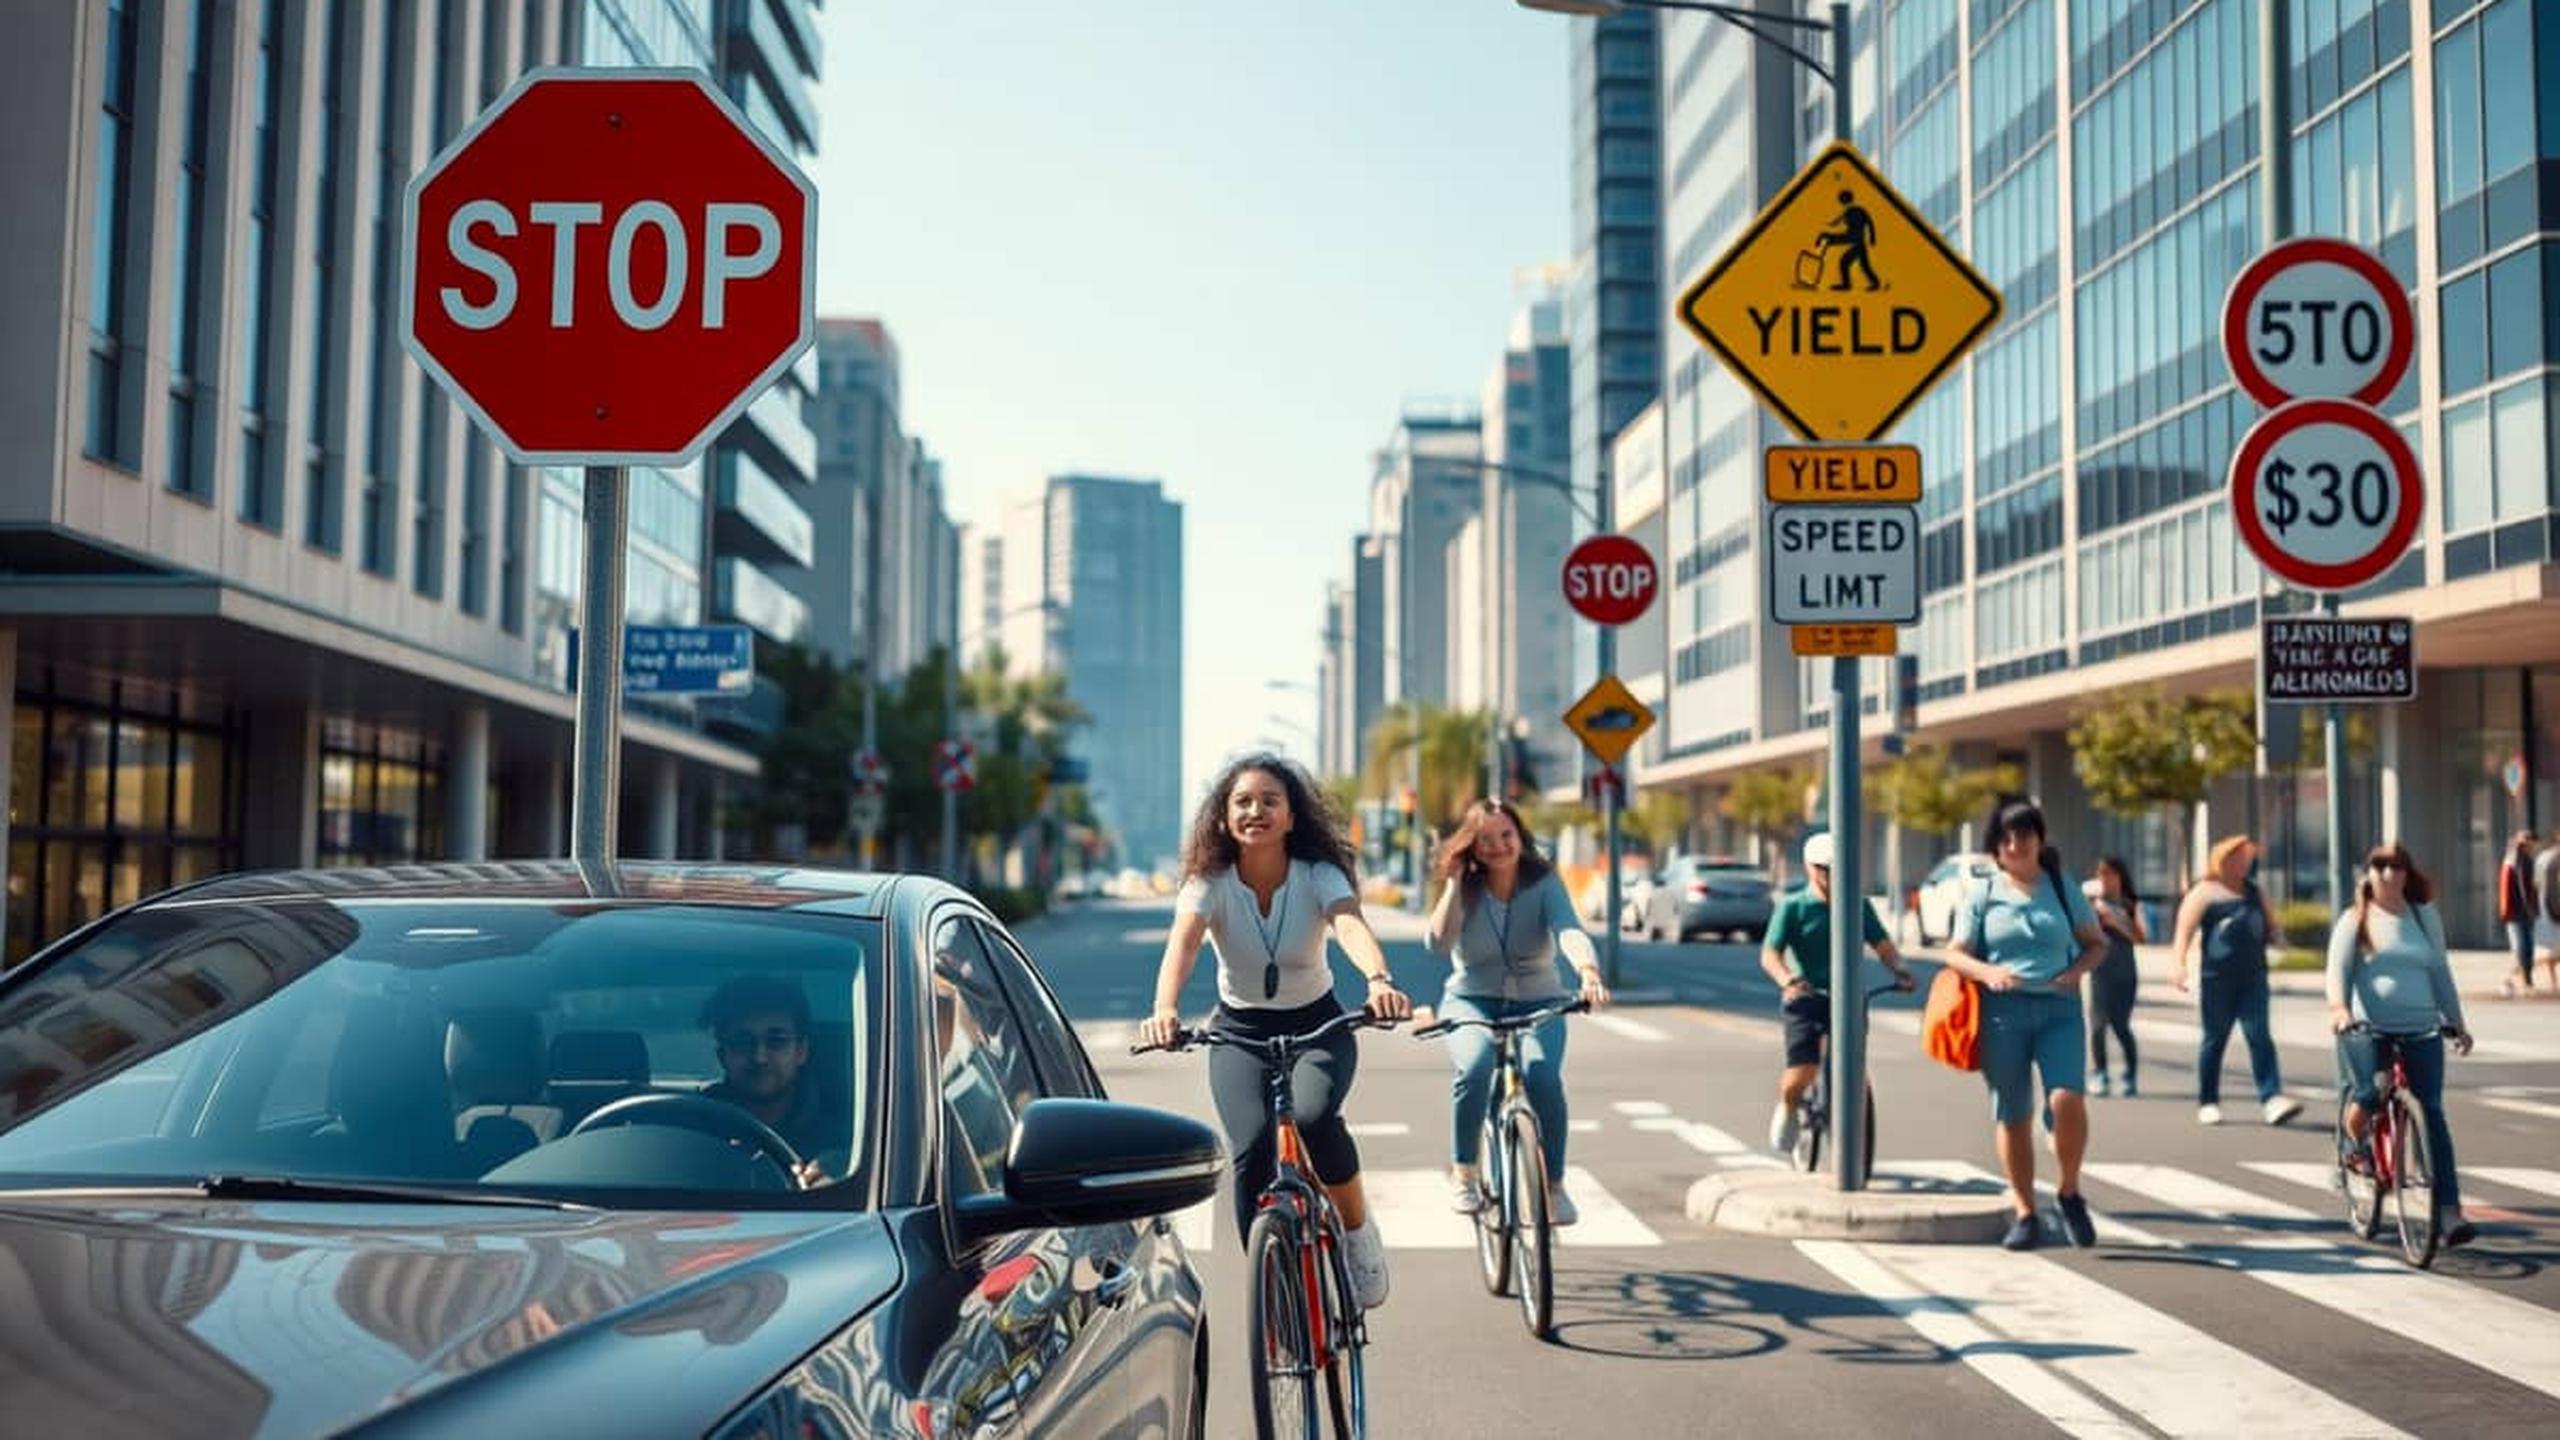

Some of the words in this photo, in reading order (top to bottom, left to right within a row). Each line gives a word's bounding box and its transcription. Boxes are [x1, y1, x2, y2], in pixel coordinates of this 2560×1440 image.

[441, 199, 782, 331] STOP
[1747, 306, 1927, 356] YIELD
[1788, 457, 1898, 491] YIELD
[2264, 457, 2390, 536] $30
[1781, 519, 1905, 552] SPEED
[1568, 563, 1652, 599] STOP
[1800, 573, 1886, 608] LIMT
